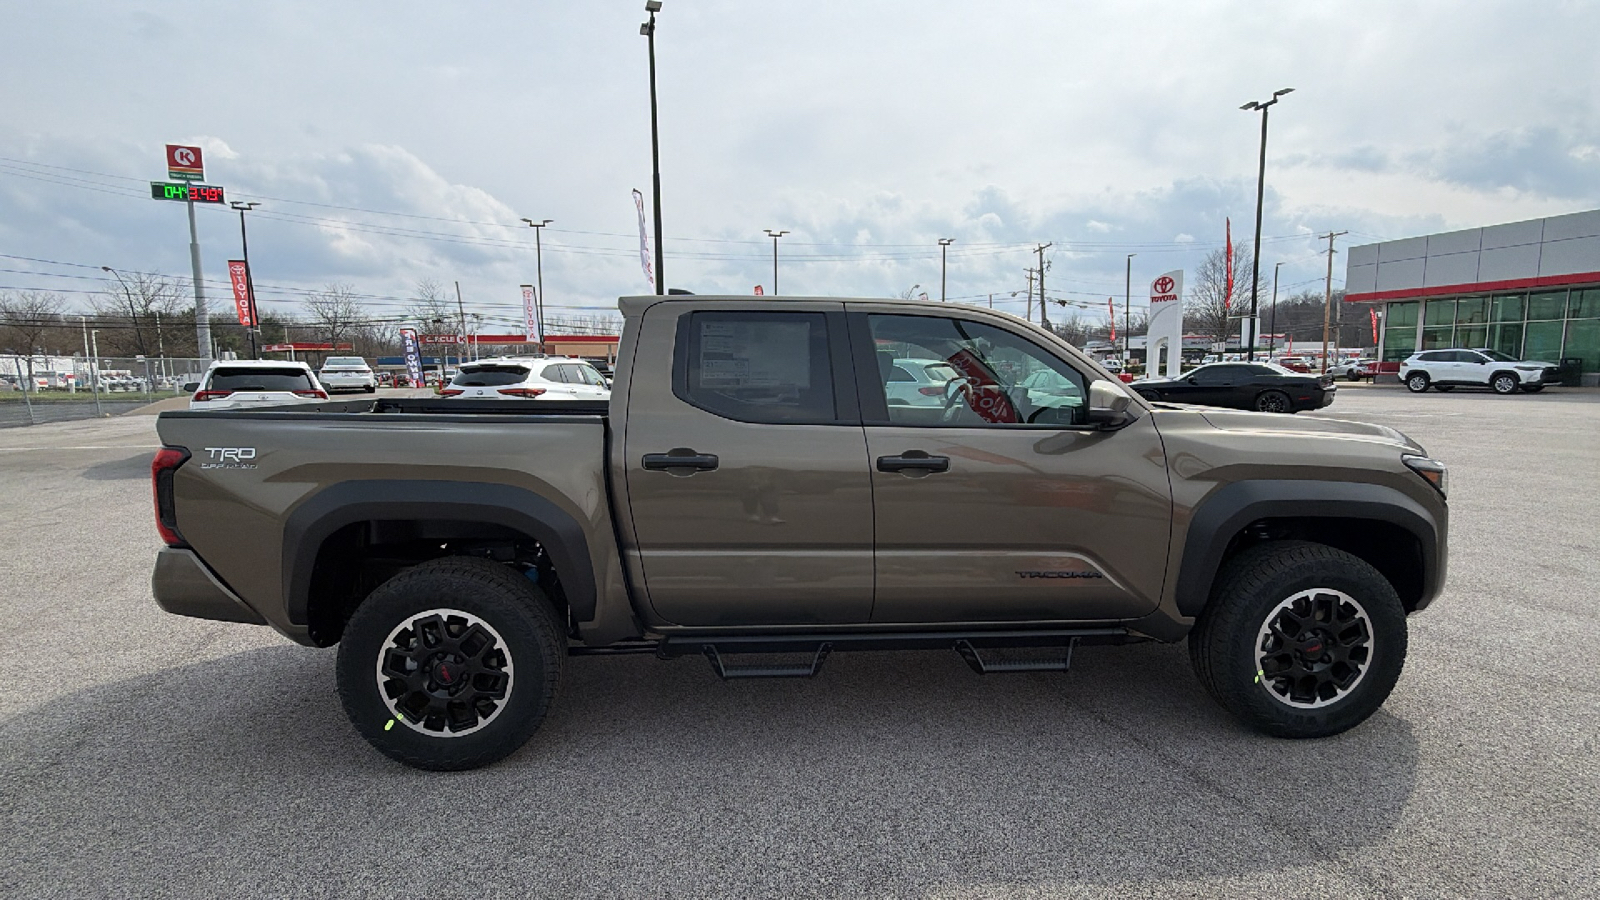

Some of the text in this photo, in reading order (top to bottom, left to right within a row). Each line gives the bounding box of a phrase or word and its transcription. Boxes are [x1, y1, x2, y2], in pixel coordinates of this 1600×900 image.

[178, 150, 195, 165] K
[236, 276, 250, 323] TOYOTA
[1150, 294, 1178, 303] TOYOTA
[526, 299, 536, 339] TOYOTA
[204, 447, 256, 462] TRD
